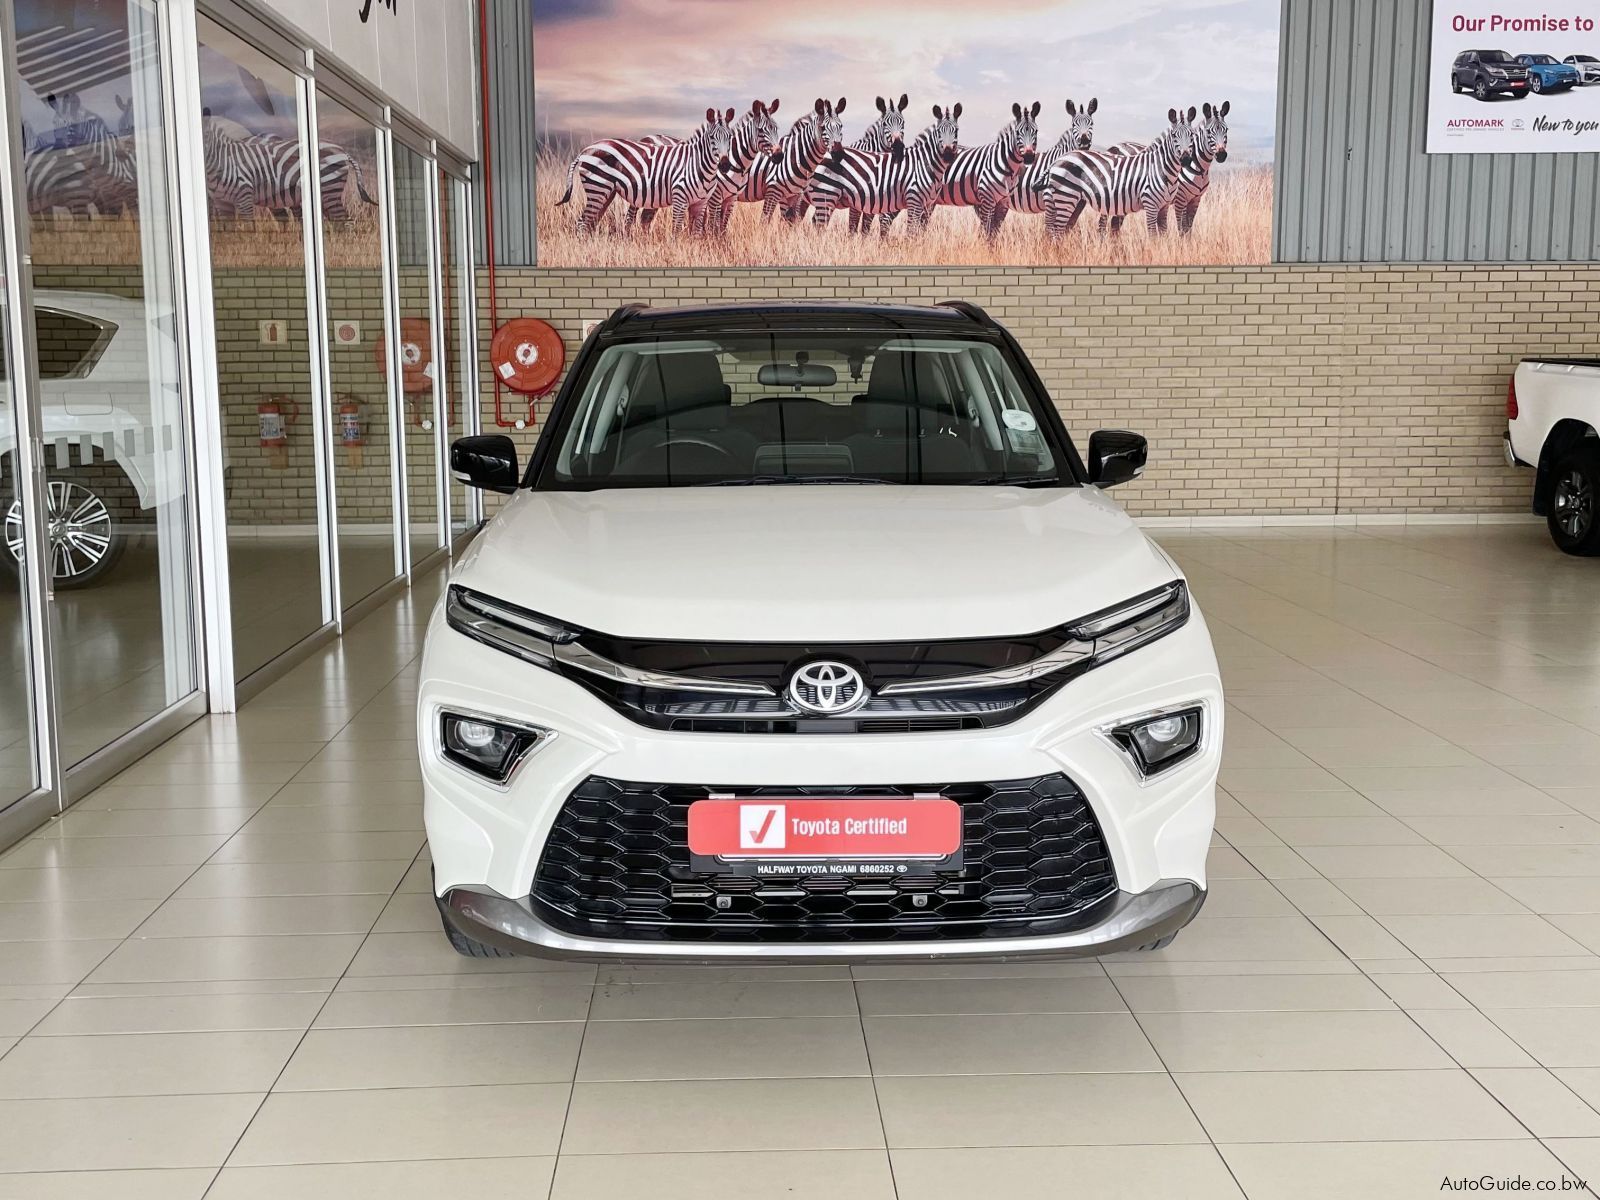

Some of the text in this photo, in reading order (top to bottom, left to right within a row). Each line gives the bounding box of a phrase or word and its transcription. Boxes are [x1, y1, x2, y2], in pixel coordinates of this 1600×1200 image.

[1452, 14, 1595, 32] Our Promise to
[1446, 119, 1505, 128] AUTOMARK
[1532, 115, 1560, 133] New
[1561, 118, 1574, 131] to
[791, 817, 908, 836] Toyota Certified
[757, 864, 895, 874] HALFWAY TOYOTA NGAMI 6860252
